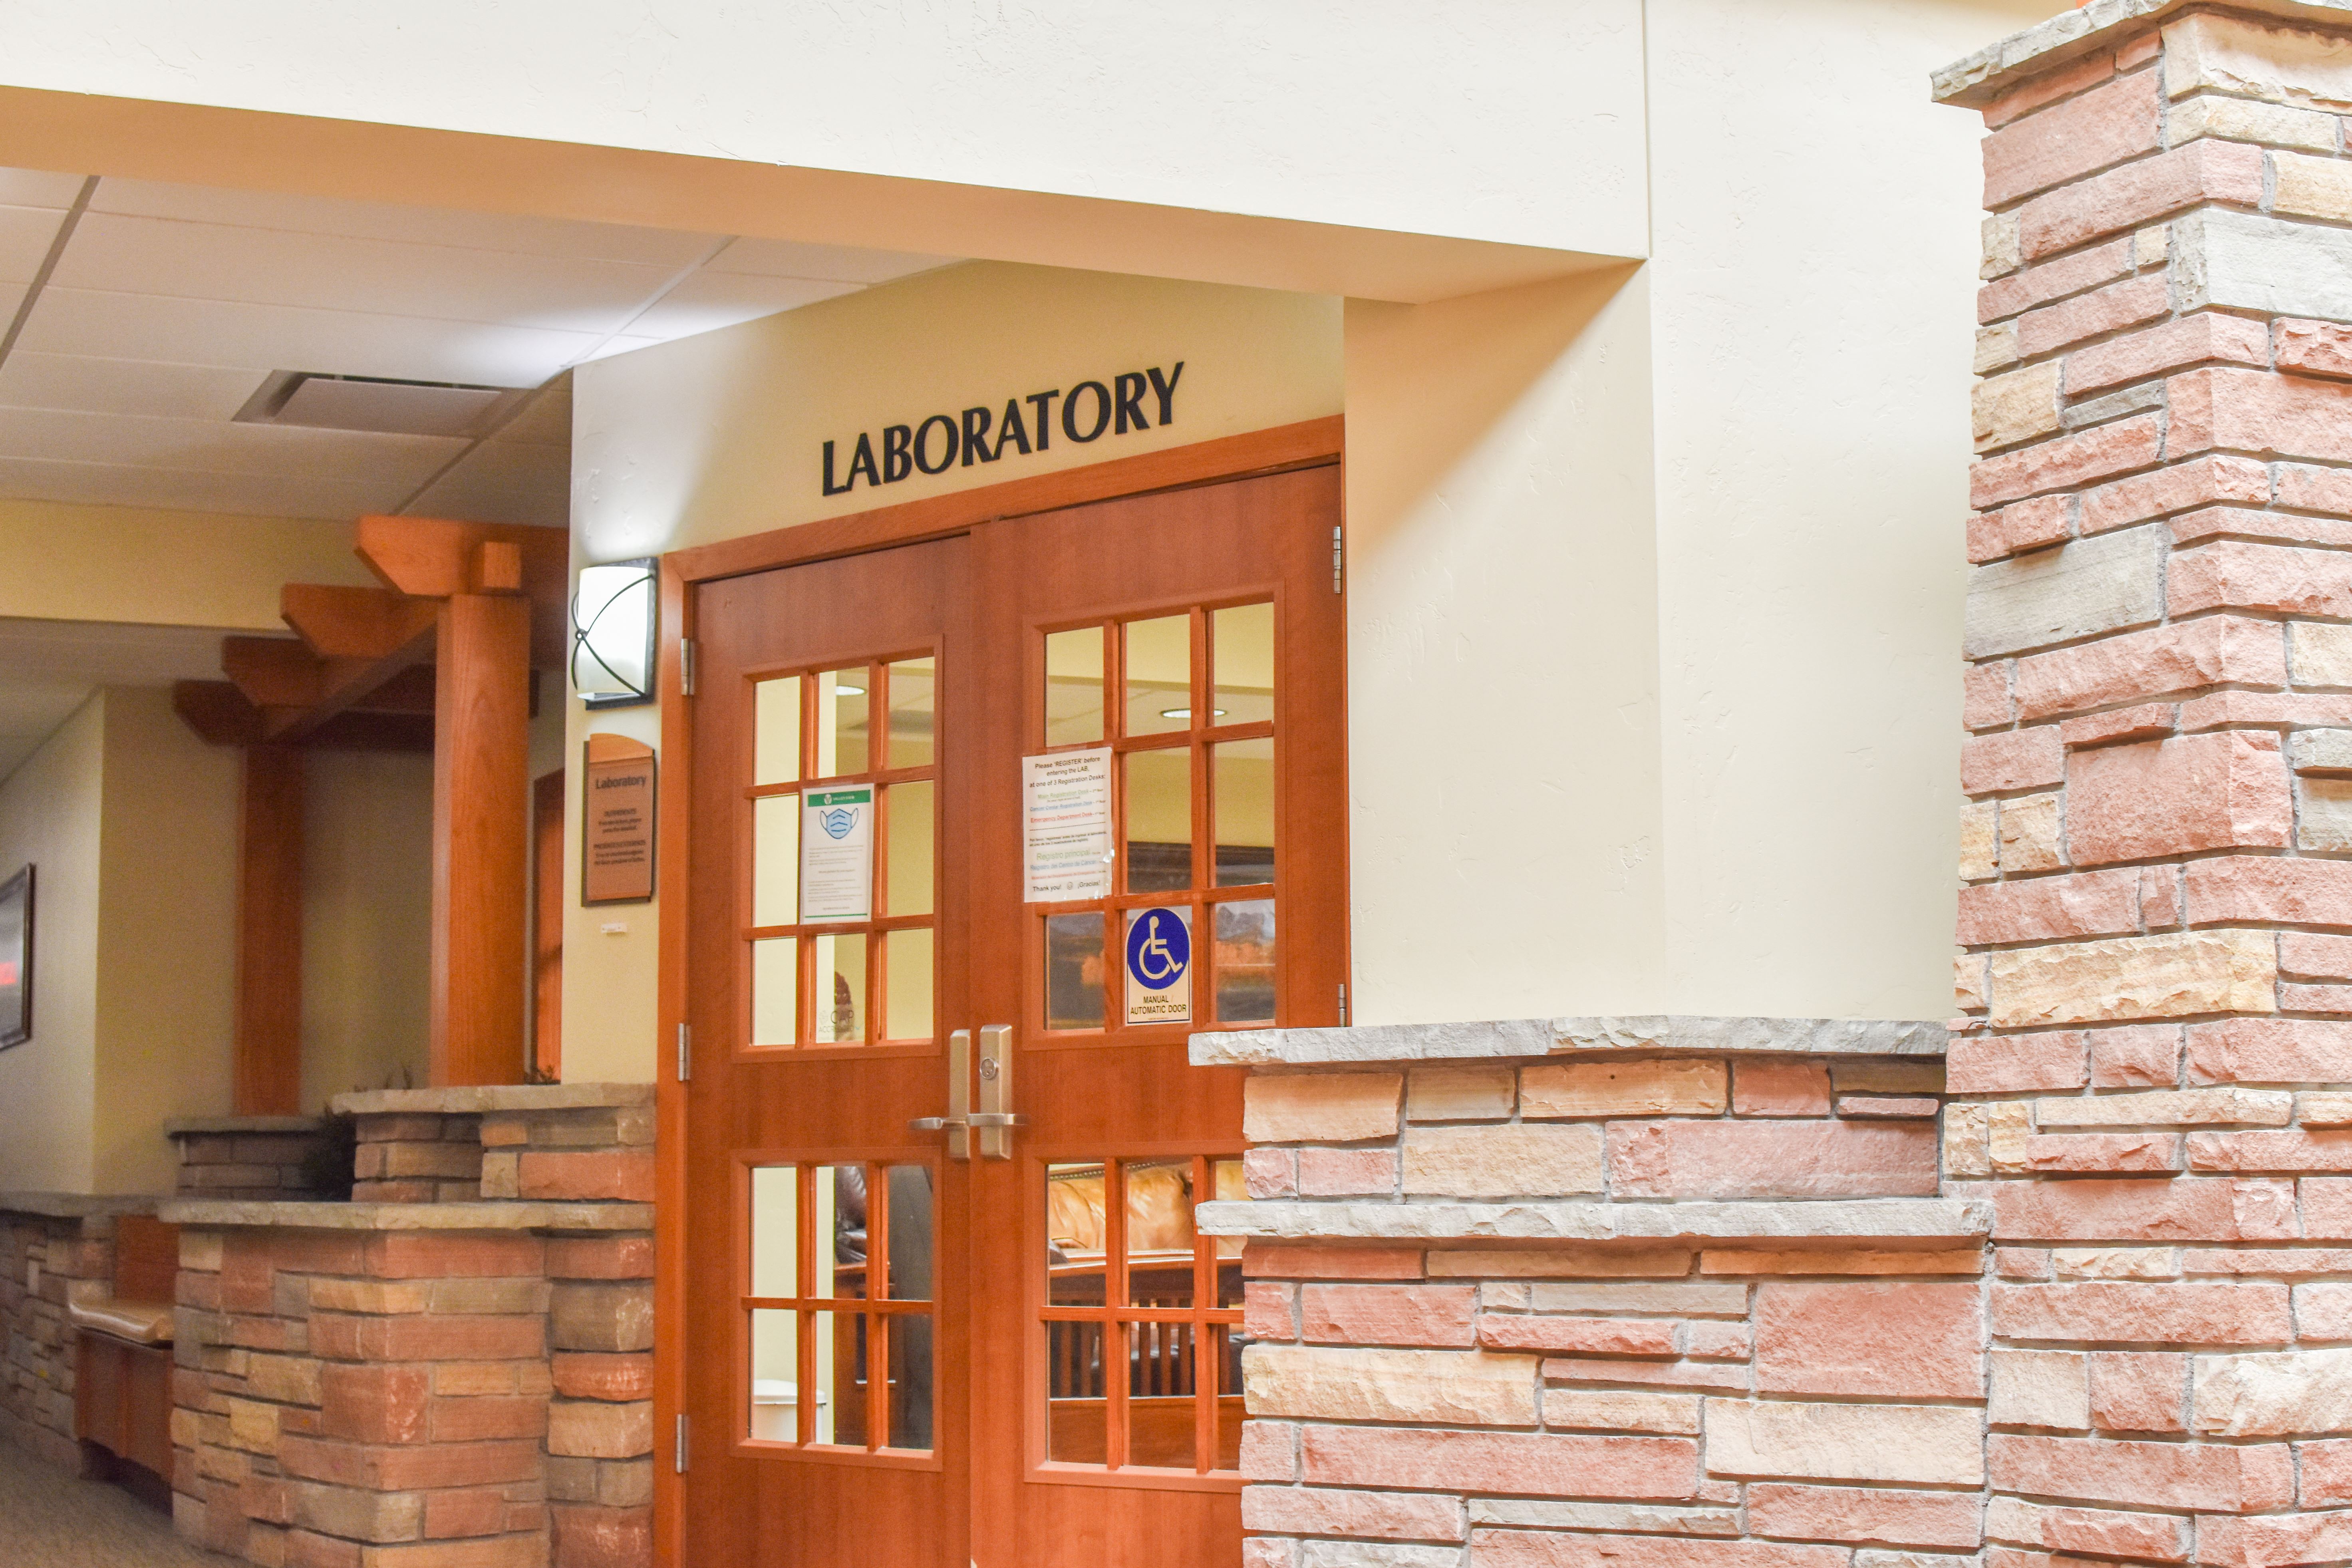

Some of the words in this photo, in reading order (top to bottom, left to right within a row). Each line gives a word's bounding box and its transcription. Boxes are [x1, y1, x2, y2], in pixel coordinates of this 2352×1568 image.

[822, 361, 1184, 496] LABORATORY
[596, 777, 646, 789] Laboratory
[1058, 776, 1088, 785] Registration
[1037, 853, 1063, 861] Registro
[1065, 849, 1090, 859] principal
[1078, 880, 1100, 889] ¡Gracias!
[1143, 995, 1169, 1004] MANUAL
[1130, 1005, 1166, 1014] AUTOMATIC
[1168, 1004, 1186, 1013] DOOR
